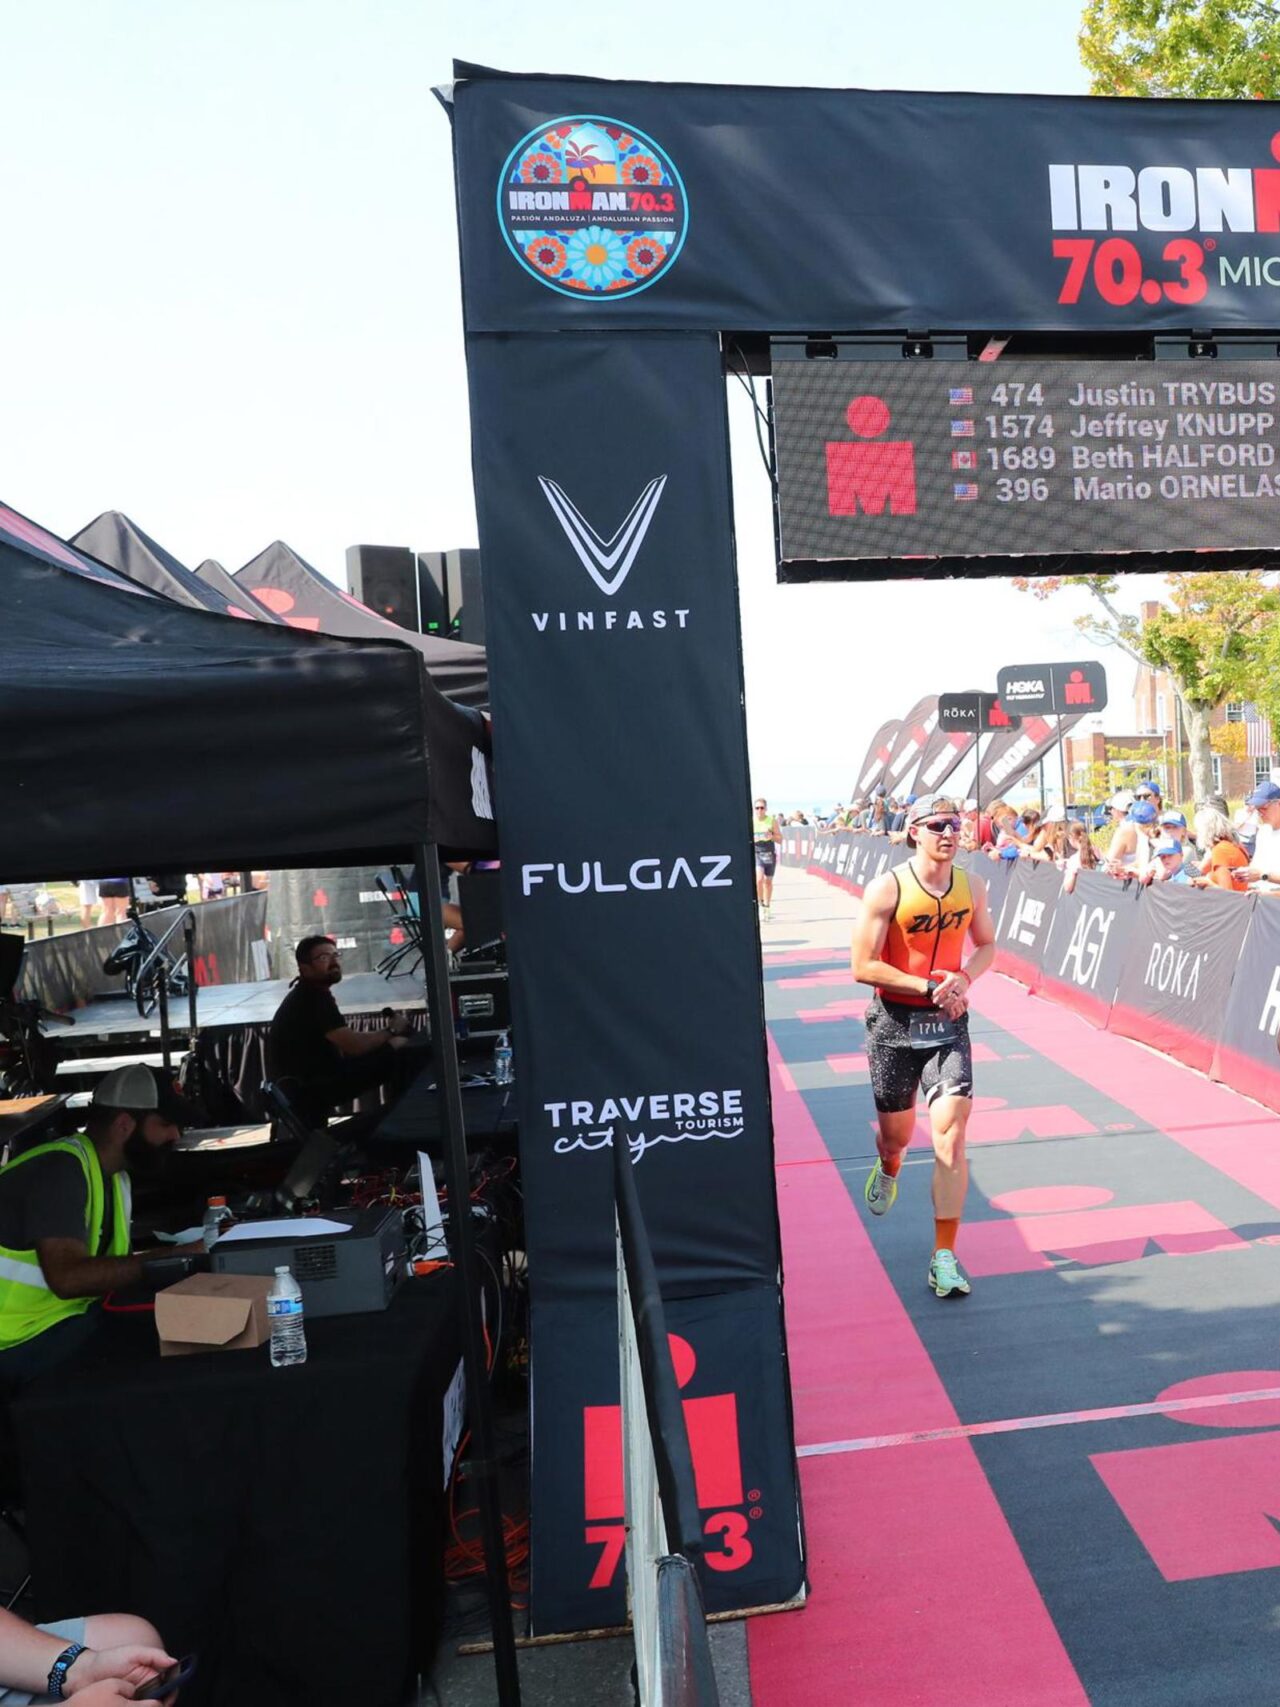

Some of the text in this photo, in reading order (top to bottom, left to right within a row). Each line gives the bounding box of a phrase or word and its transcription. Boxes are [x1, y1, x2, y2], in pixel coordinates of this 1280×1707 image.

[509, 181, 676, 211] IRONMAN 70.3
[1052, 237, 1210, 306] 70.3
[991, 383, 1045, 407] 474
[1068, 382, 1156, 406] Justin
[1162, 381, 1276, 405] TRYBUS
[985, 414, 1055, 439] 1574
[1070, 413, 1172, 443] Jeffrey
[1176, 412, 1275, 437] KNUPP
[986, 446, 1056, 471] 1689
[1072, 445, 1133, 469] Beth
[1141, 442, 1276, 468] HALFORD
[996, 477, 1049, 502] 396
[1073, 476, 1151, 500] Mario
[531, 608, 690, 631] VINFAST
[1005, 680, 1045, 694] HOKA
[521, 854, 734, 896] FULGAZ
[907, 908, 970, 934] ZOOT
[919, 1022, 945, 1035] 1714
[543, 1089, 744, 1128] TRAVERSE
[674, 1116, 744, 1131] TOURISM
[585, 1511, 754, 1589] 73
